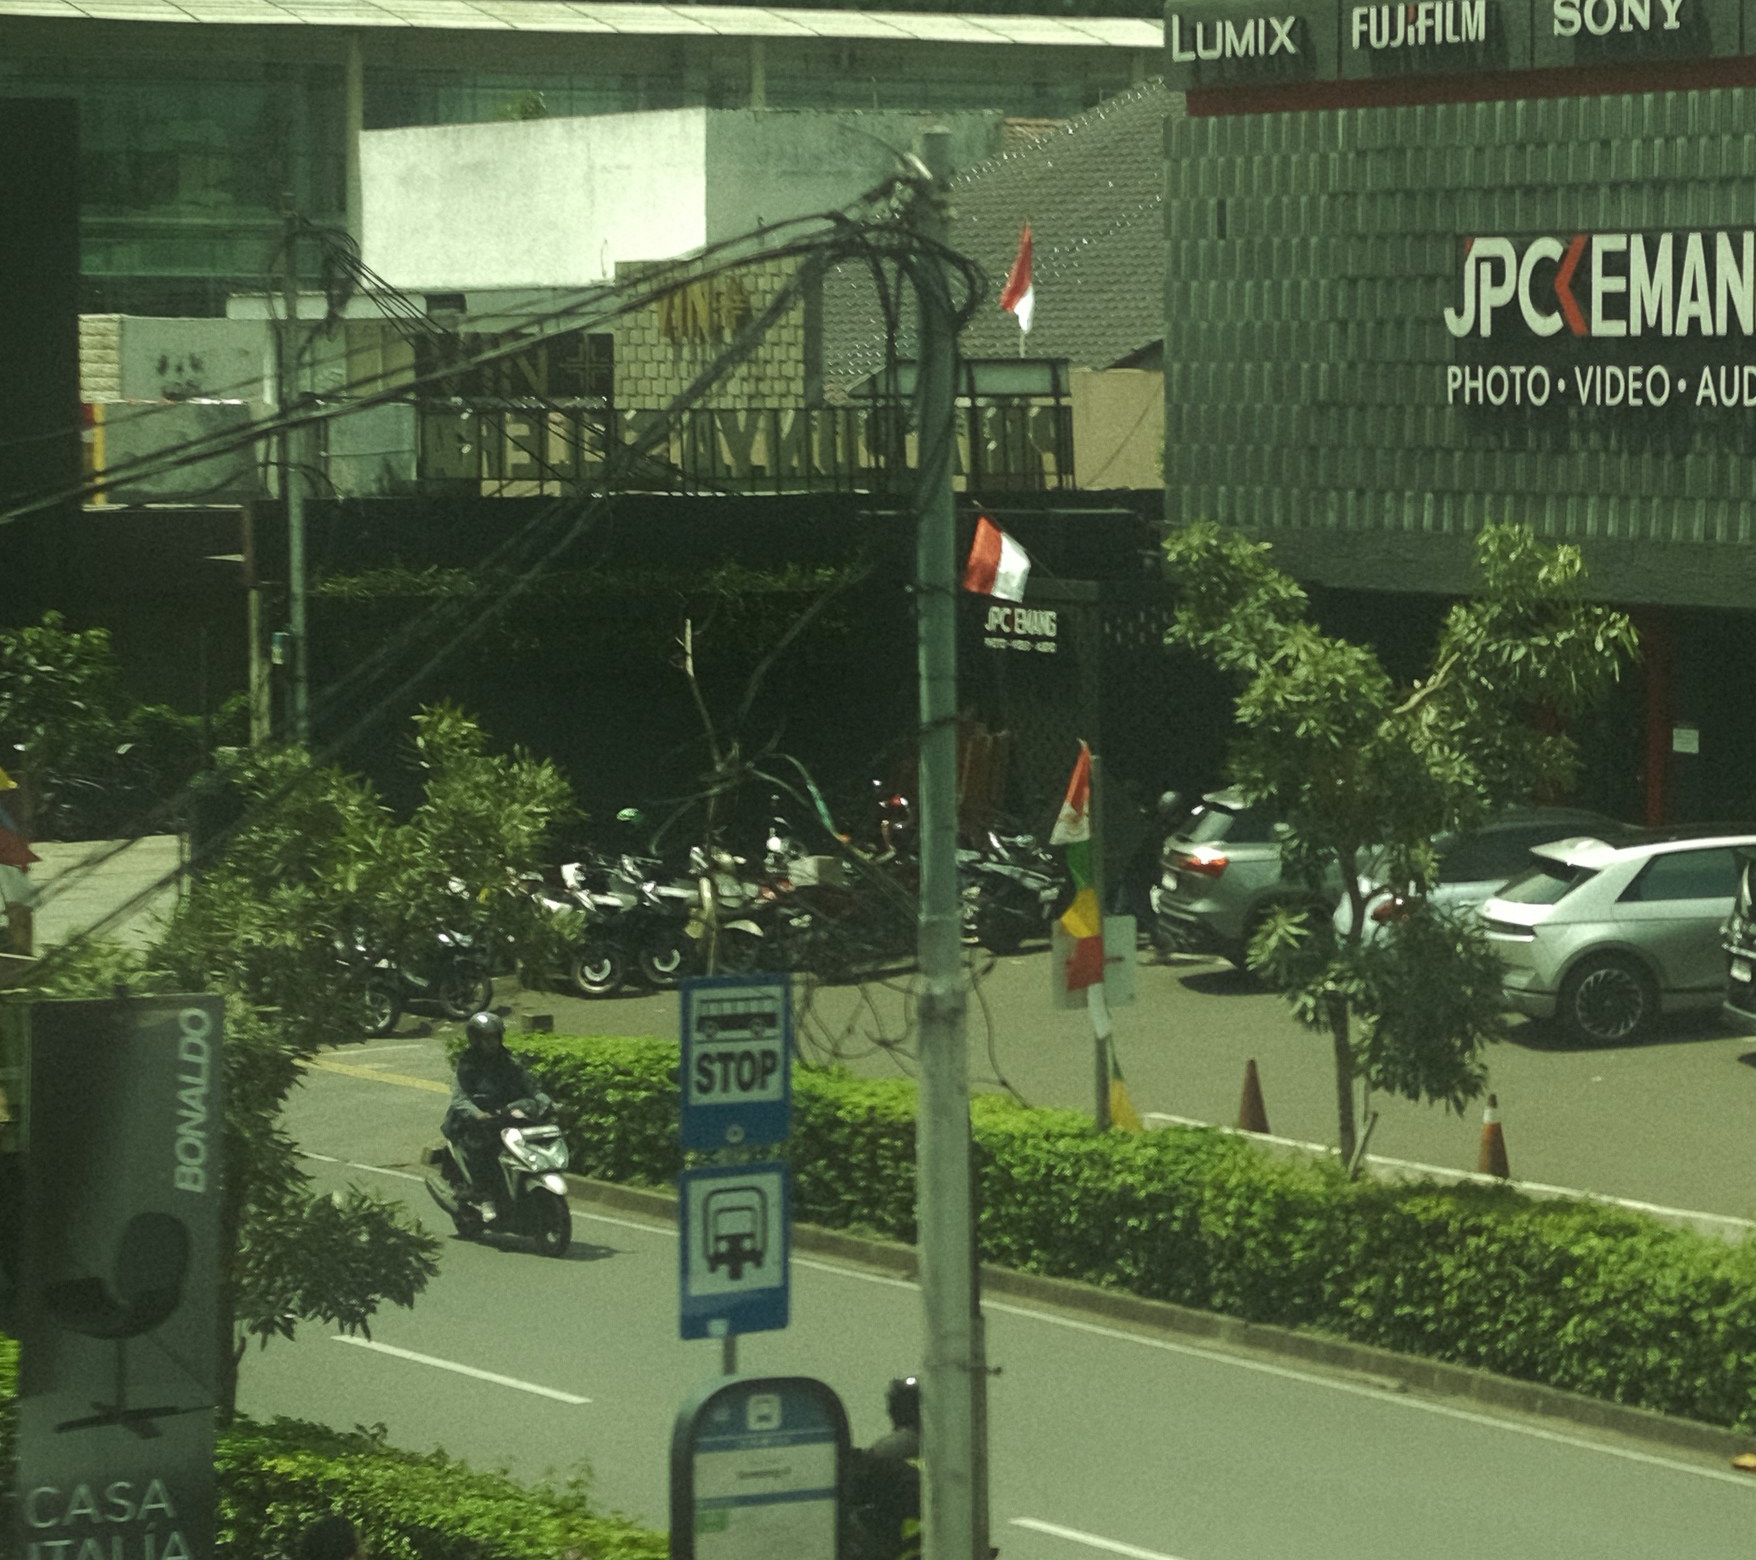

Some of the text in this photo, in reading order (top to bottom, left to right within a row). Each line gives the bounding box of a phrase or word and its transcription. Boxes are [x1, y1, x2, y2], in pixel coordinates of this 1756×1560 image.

[1171, 13, 1298, 63] LUMIX
[1446, 364, 1551, 407] PHOTO
[1573, 363, 1671, 407] VIDEO
[696, 1048, 780, 1096] STOP
[173, 1006, 213, 1194] BONALDO
[25, 1477, 178, 1530] CASA
